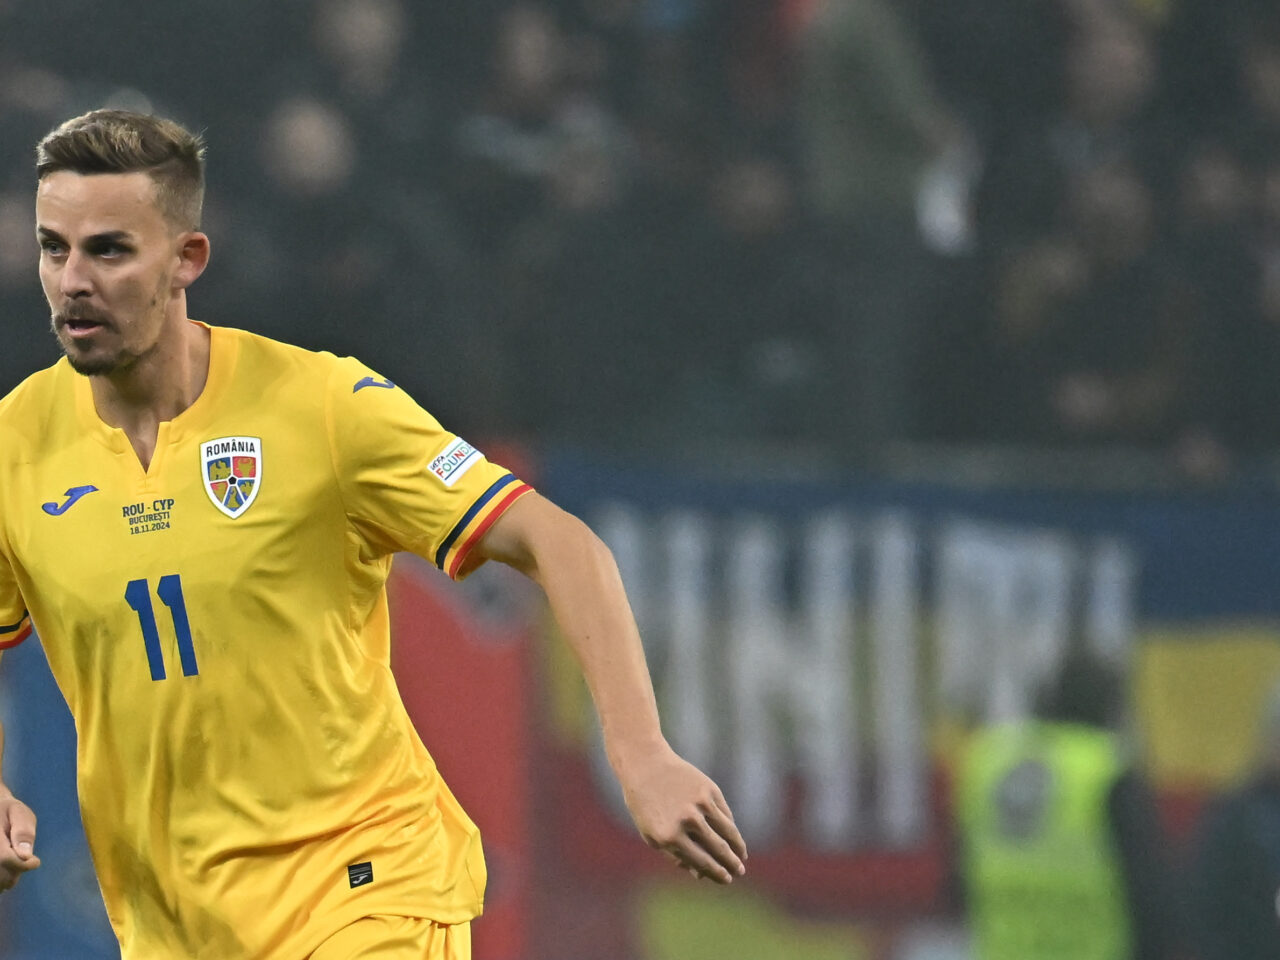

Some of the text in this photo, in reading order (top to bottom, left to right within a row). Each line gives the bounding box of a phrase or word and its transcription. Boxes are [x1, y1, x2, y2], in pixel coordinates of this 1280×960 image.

[206, 439, 255, 457] ROMÂNIA
[122, 502, 144, 517] ROU
[153, 498, 174, 511] CYP
[130, 521, 170, 534] 18.11.2024
[124, 573, 199, 681] 11
